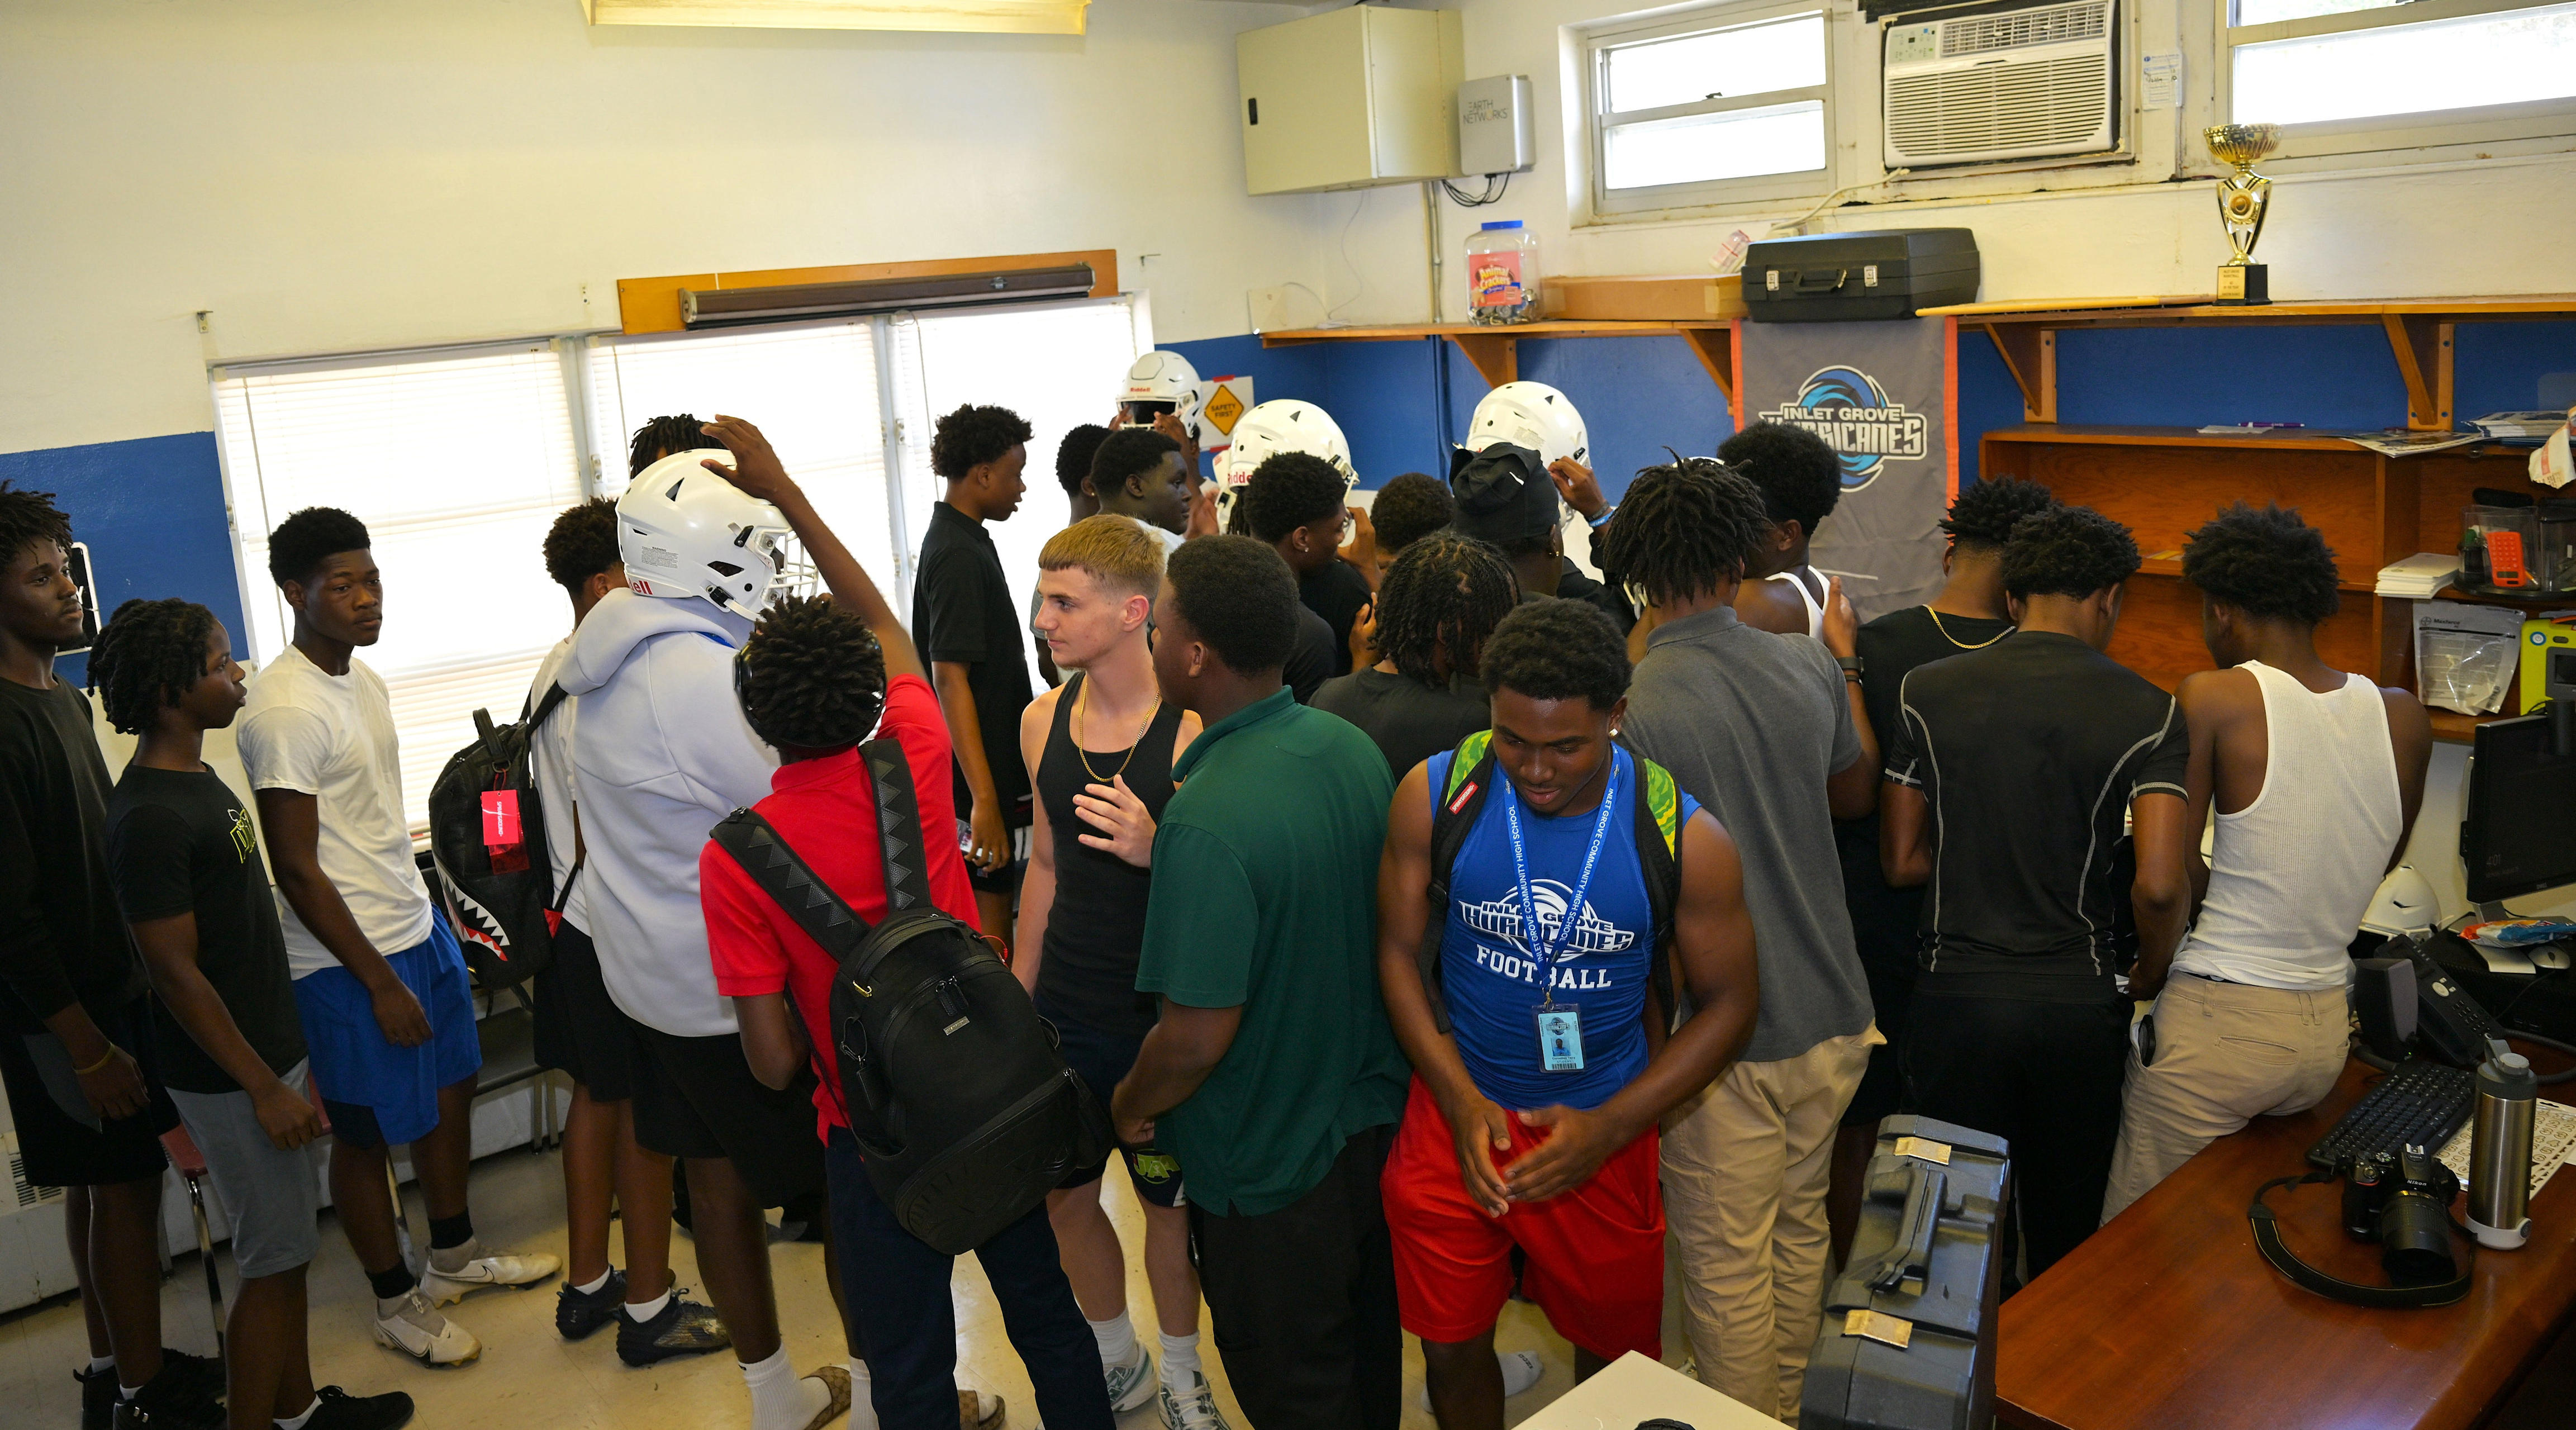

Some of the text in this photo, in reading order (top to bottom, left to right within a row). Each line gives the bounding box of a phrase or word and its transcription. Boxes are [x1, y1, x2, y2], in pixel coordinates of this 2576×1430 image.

[1468, 99, 1493, 112] EARTH
[1463, 108, 1508, 123] NETWORKS
[1479, 265, 1510, 279] Animal
[1480, 275, 1511, 290] Crackers
[1211, 404, 1236, 412] SAFETY
[1784, 407, 1900, 421] INLET GROVE
[1559, 788, 1615, 942] INLET GROVE COMMUNITY HIGH SCHOOL
[1508, 805, 1544, 963] INLET GROVE COMMUNITY HIGH SCHOOL
[1476, 944, 1612, 990] FOOTBALL
